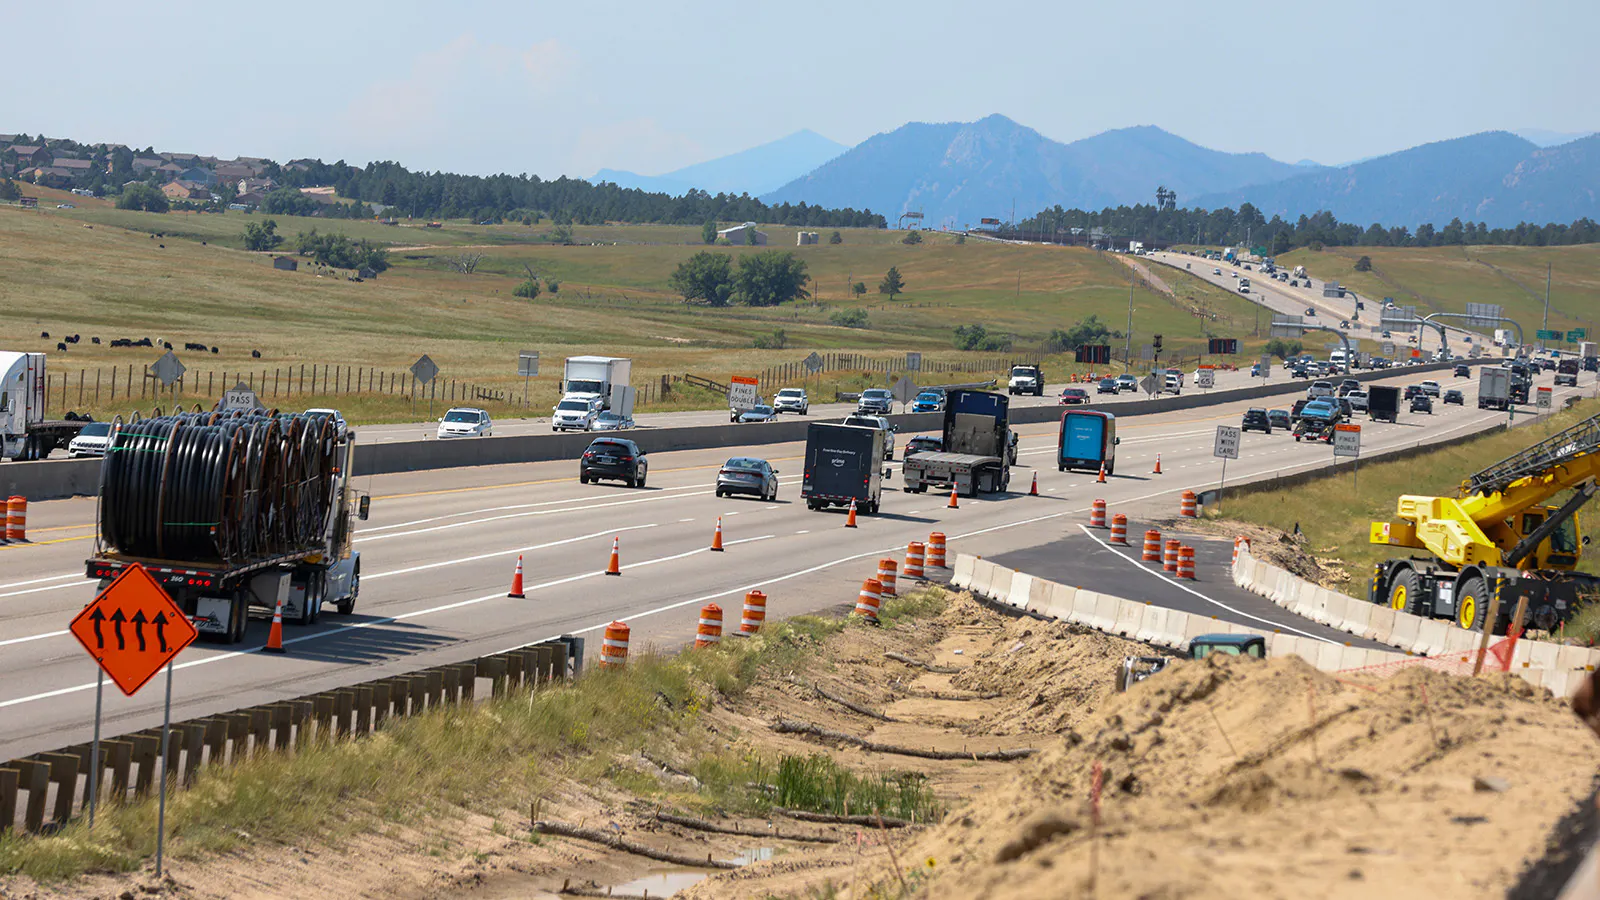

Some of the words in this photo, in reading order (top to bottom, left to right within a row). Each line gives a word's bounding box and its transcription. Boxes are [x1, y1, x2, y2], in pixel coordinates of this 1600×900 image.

[735, 387, 752, 395] FINES
[230, 395, 250, 404] PASS
[731, 396, 754, 404] DOUBLE
[1220, 429, 1237, 438] PASS
[1221, 439, 1235, 447] WITH
[1218, 447, 1234, 456] CARE
